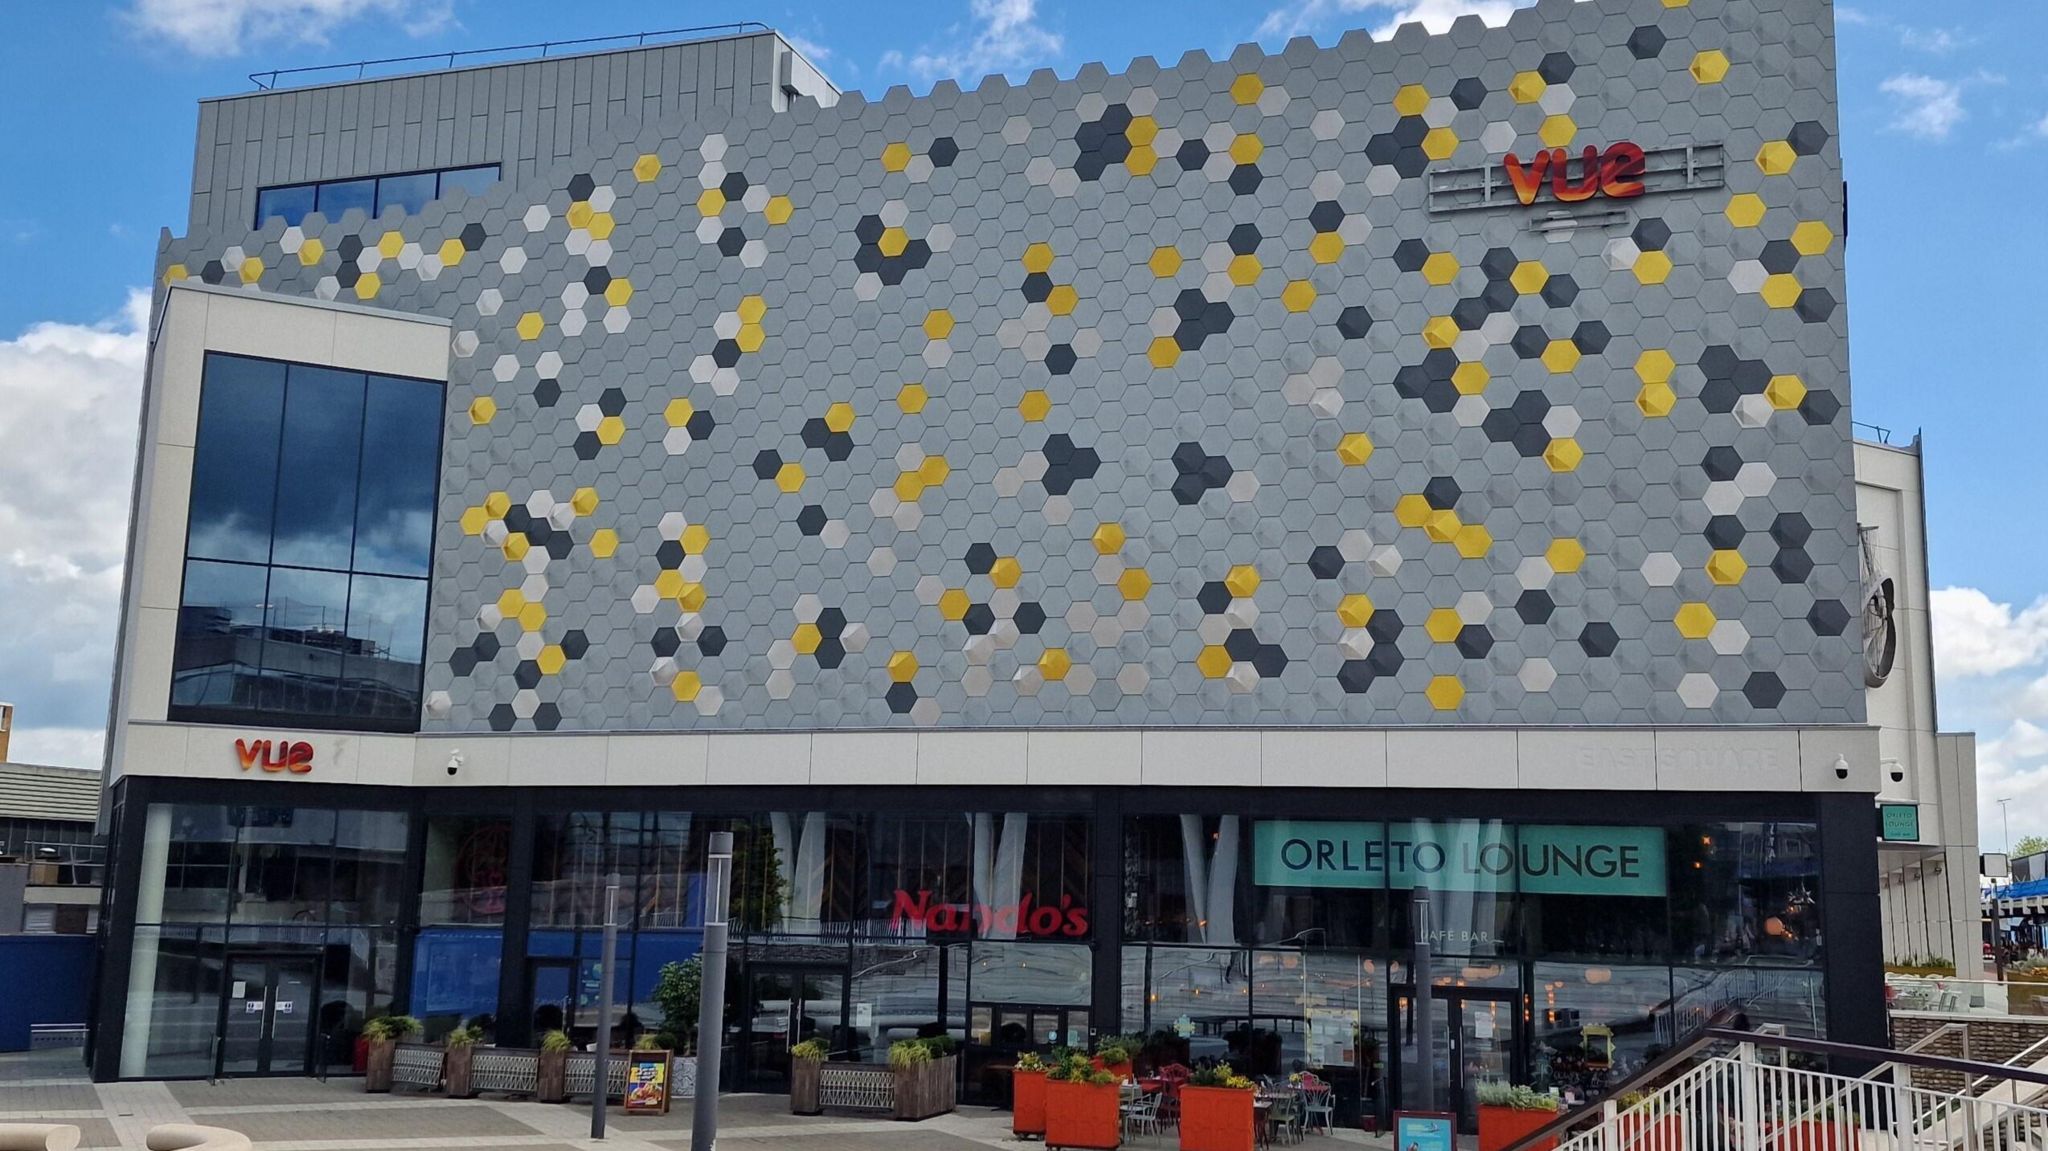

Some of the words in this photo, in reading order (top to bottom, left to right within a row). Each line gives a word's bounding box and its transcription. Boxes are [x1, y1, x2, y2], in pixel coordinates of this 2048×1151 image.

[1281, 838, 1446, 874] ORLETO
[1462, 841, 1640, 879] LOUNGE
[892, 889, 1090, 937] Nando's
[1461, 931, 1488, 942] BAR
